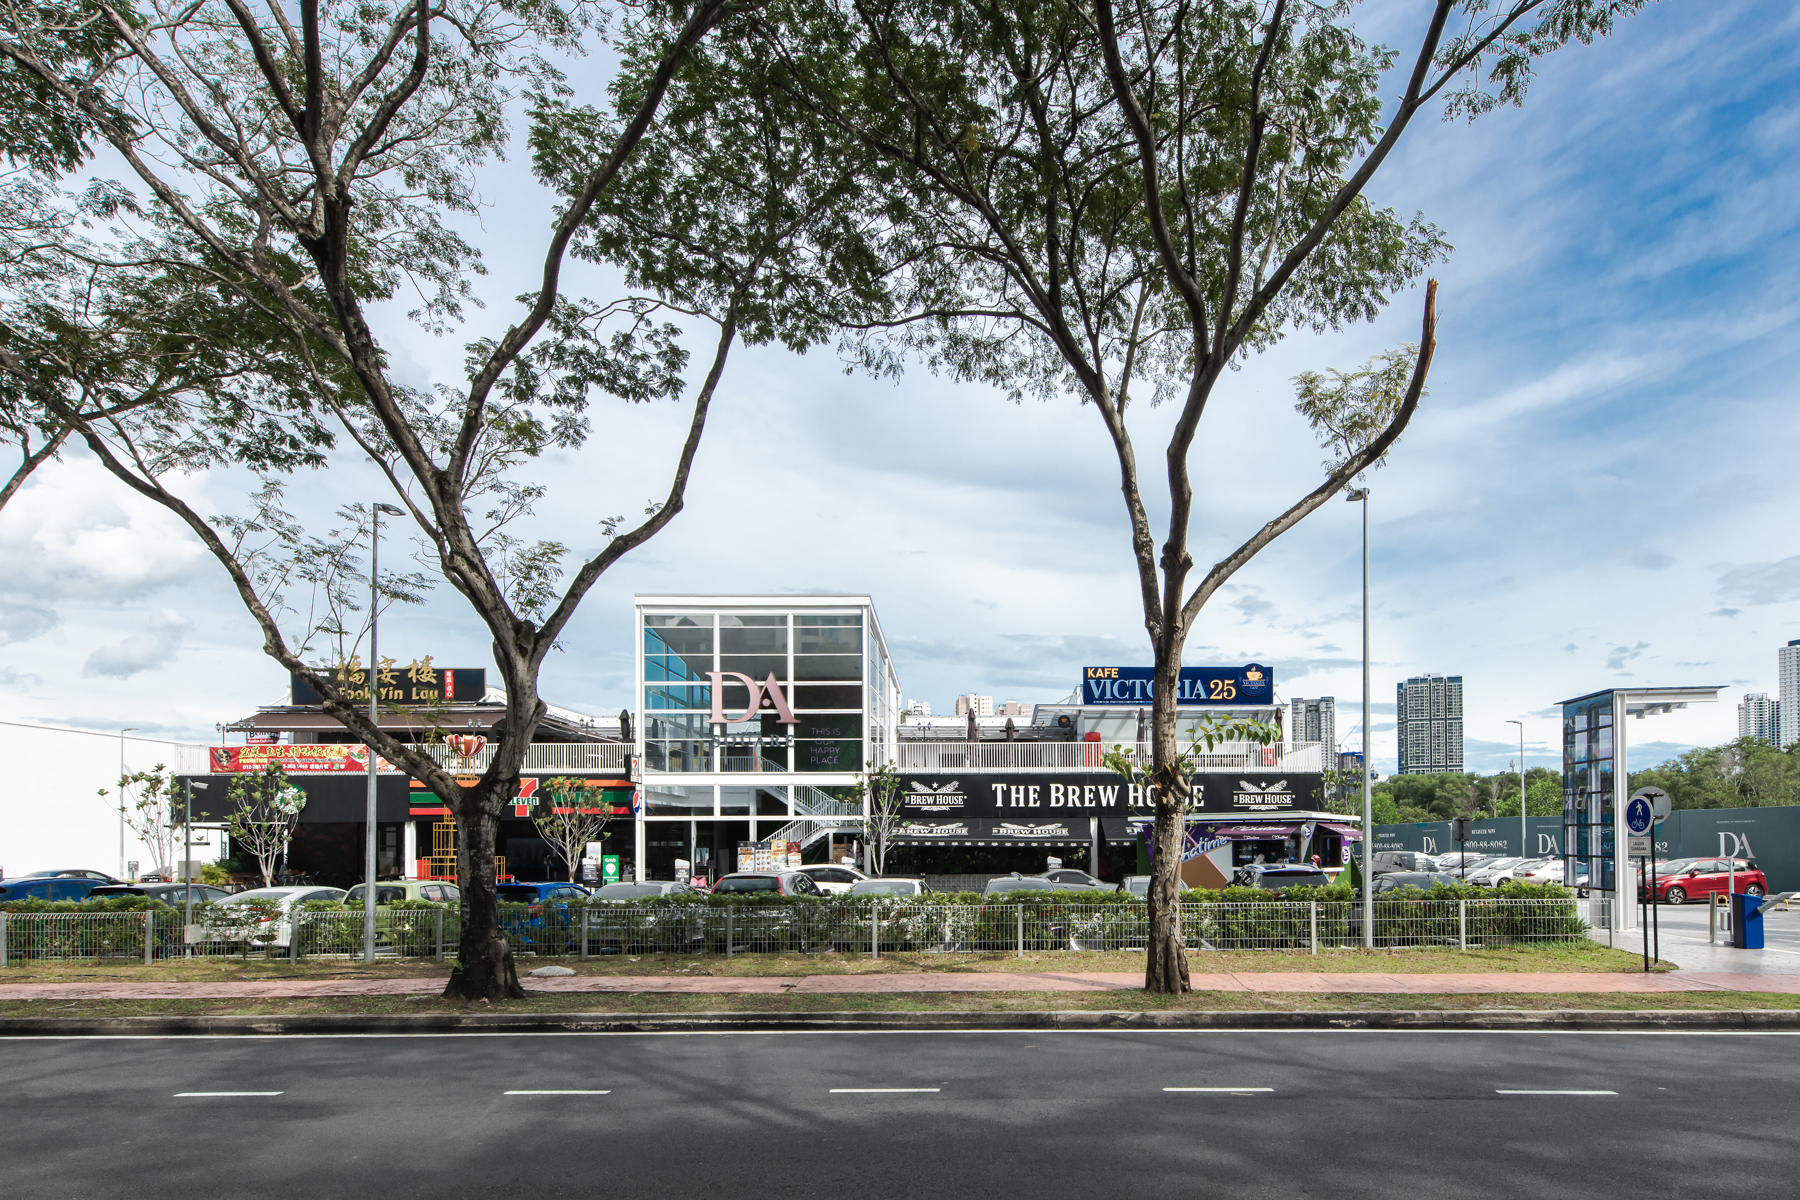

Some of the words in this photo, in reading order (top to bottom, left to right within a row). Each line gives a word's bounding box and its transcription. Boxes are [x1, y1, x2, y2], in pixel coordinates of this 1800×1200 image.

[1087, 668, 1119, 678] KAFE
[379, 687, 404, 700] Yin
[412, 687, 439, 700] Lau
[1088, 679, 1208, 700] VICTIA
[1209, 679, 1237, 700] 25
[705, 671, 801, 723] DA
[811, 727, 831, 736] THIS
[833, 727, 841, 736] IS
[712, 734, 796, 748] SQUARE
[811, 747, 841, 755] HAPPY
[811, 756, 839, 765] PLACE
[515, 777, 540, 818] 7
[910, 794, 934, 805] BREW
[936, 794, 964, 805] HOUSE
[992, 783, 1041, 808] THE
[1049, 783, 1120, 808] BREW
[1127, 783, 1205, 808] HOE
[1239, 794, 1263, 804] BREW
[1264, 794, 1292, 804] HOUSE
[1182, 836, 1228, 862] hatime
[1422, 836, 1439, 854] DA
[1463, 840, 1508, 850] -800-88-8082
[1537, 833, 1561, 855] DA
[1718, 831, 1757, 859] DA
